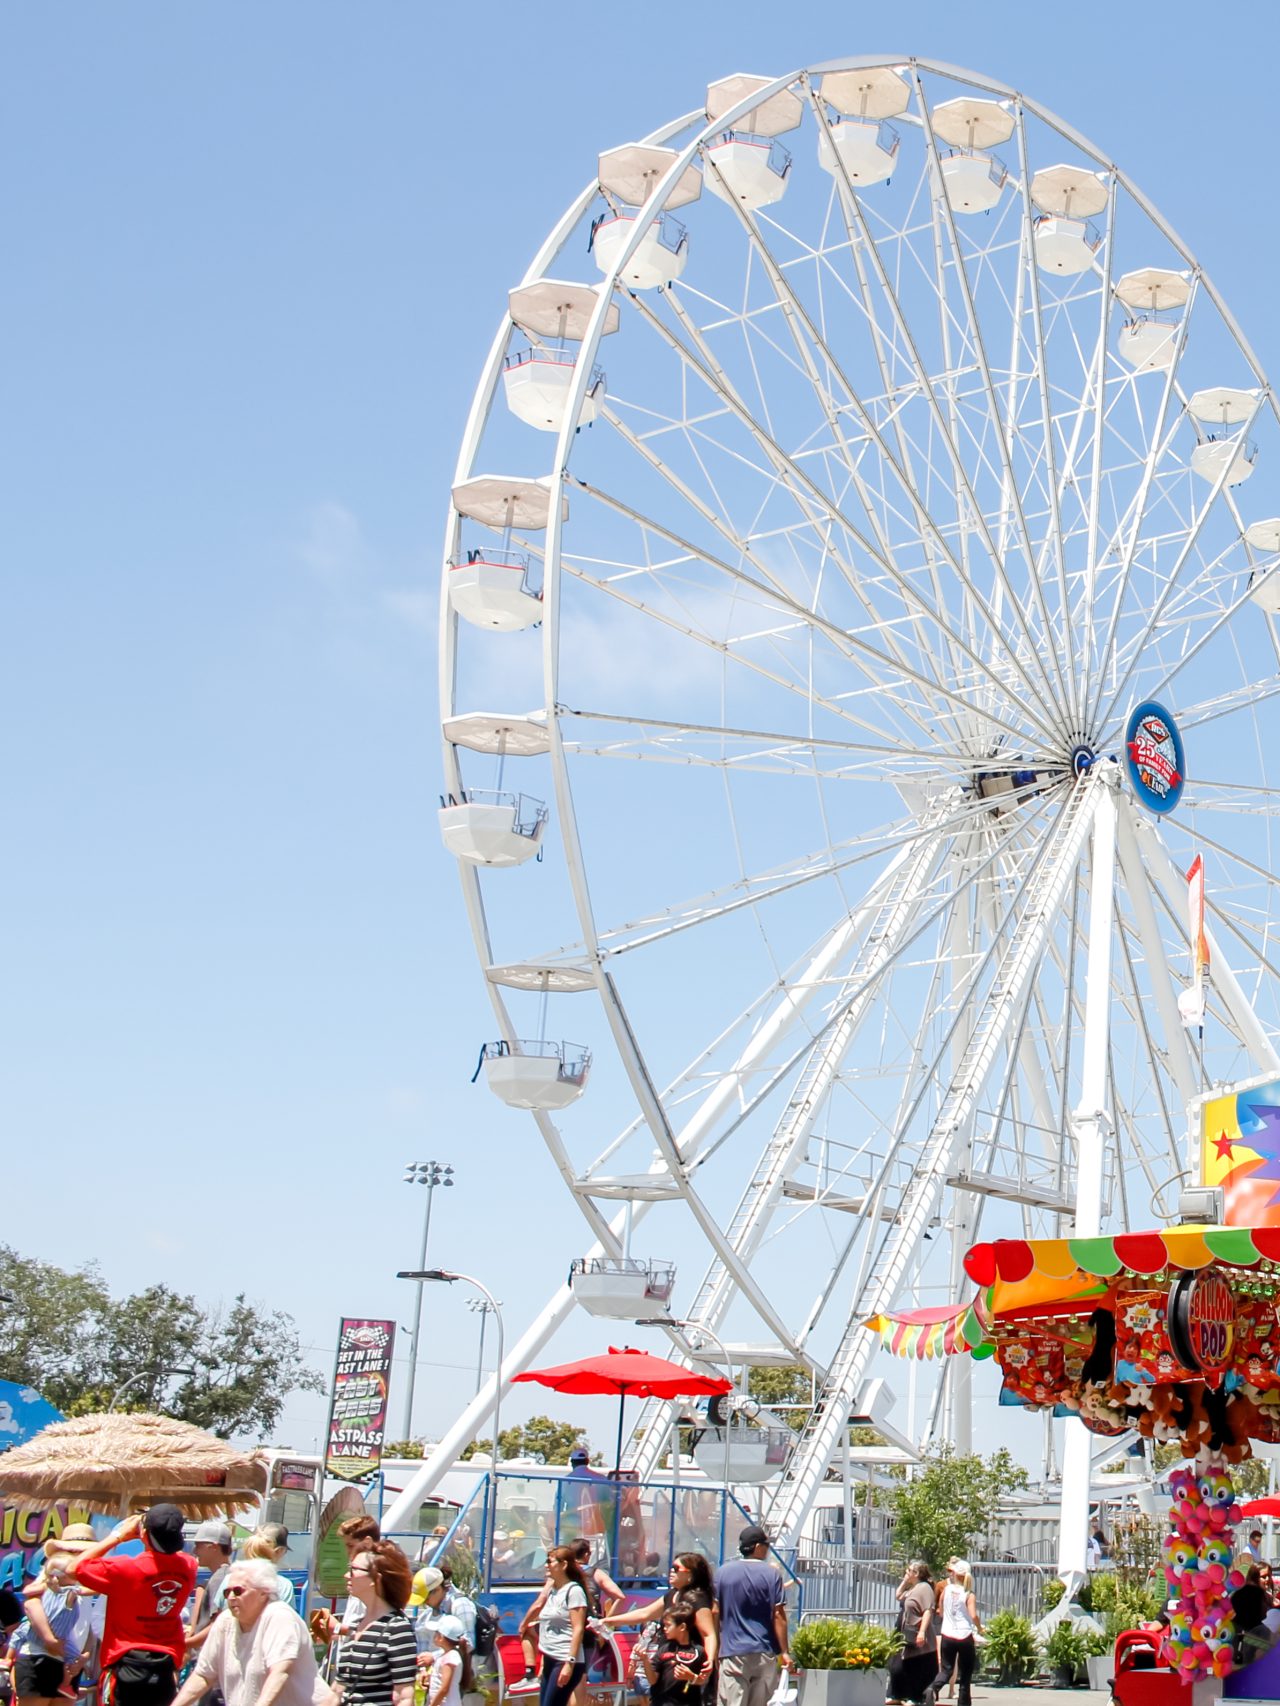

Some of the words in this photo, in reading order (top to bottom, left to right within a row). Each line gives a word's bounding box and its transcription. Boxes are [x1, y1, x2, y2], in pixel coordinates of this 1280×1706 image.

[1136, 736, 1156, 758] 25
[1193, 1278, 1233, 1321] BALLOON
[1200, 1320, 1228, 1359] POP
[354, 1350, 365, 1361] IN
[366, 1348, 384, 1359] THE
[337, 1362, 356, 1374] AST
[357, 1359, 383, 1372] LANE
[334, 1378, 380, 1400] FAST
[332, 1398, 383, 1420] PASS
[330, 1429, 383, 1445] ASTPASS
[331, 1444, 372, 1458] LANE
